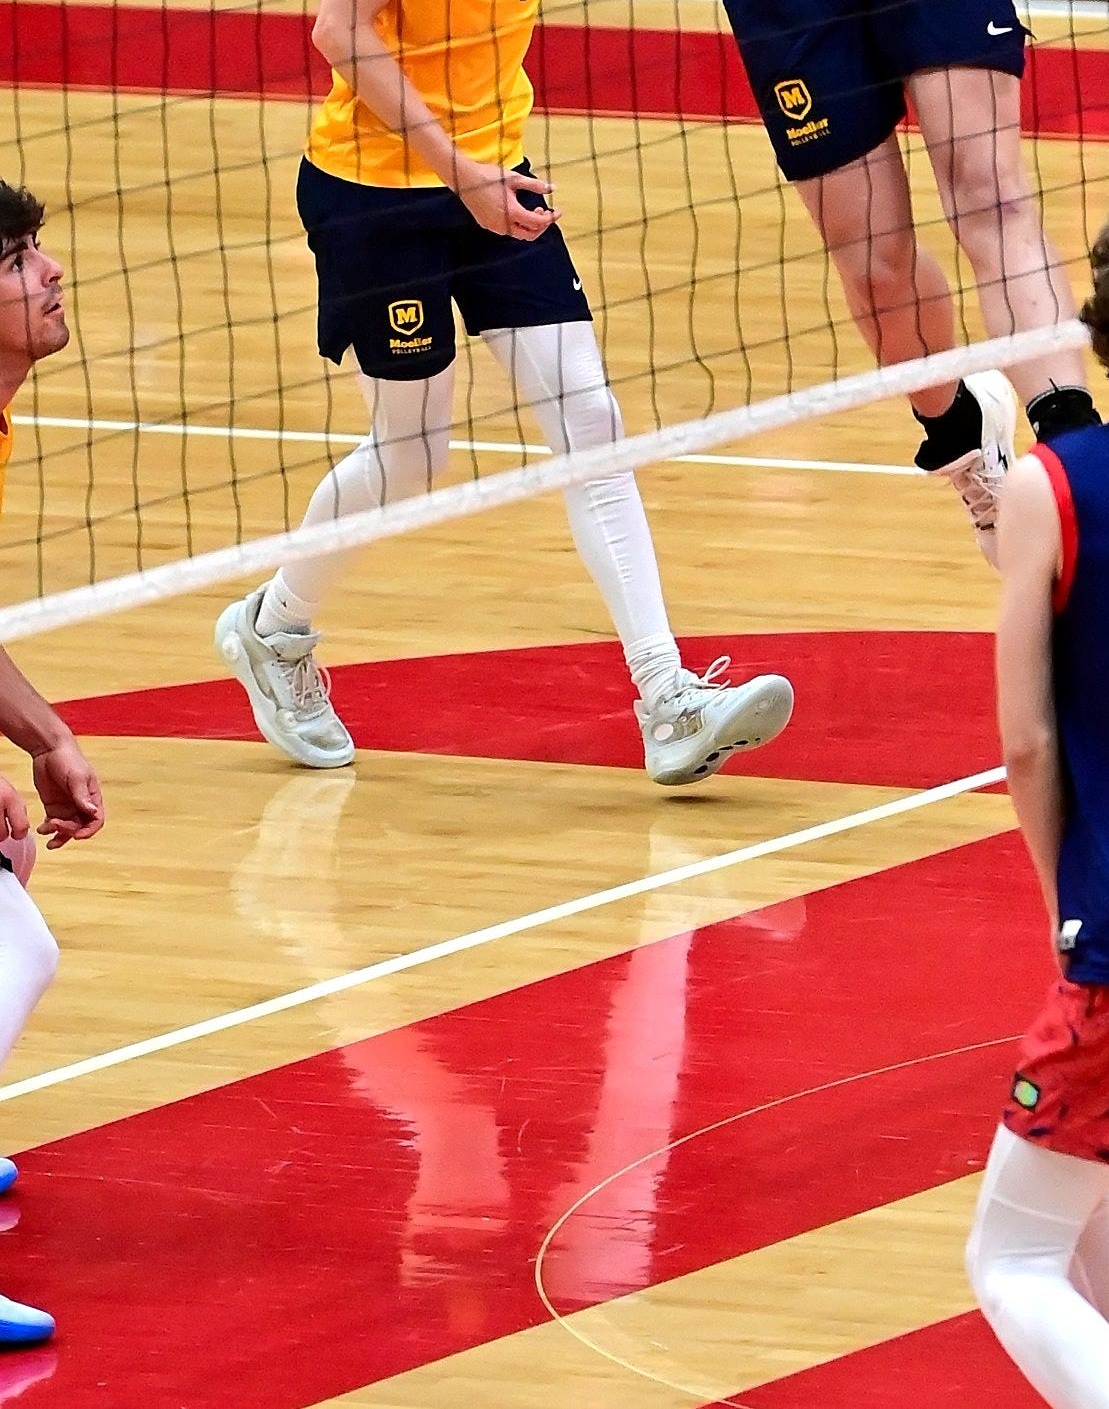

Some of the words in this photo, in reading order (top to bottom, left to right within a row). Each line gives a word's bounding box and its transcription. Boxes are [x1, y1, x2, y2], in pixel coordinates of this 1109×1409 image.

[780, 86, 806, 109] M
[786, 118, 829, 140] Moeller
[395, 306, 418, 325] M
[389, 336, 433, 348] Moeller
